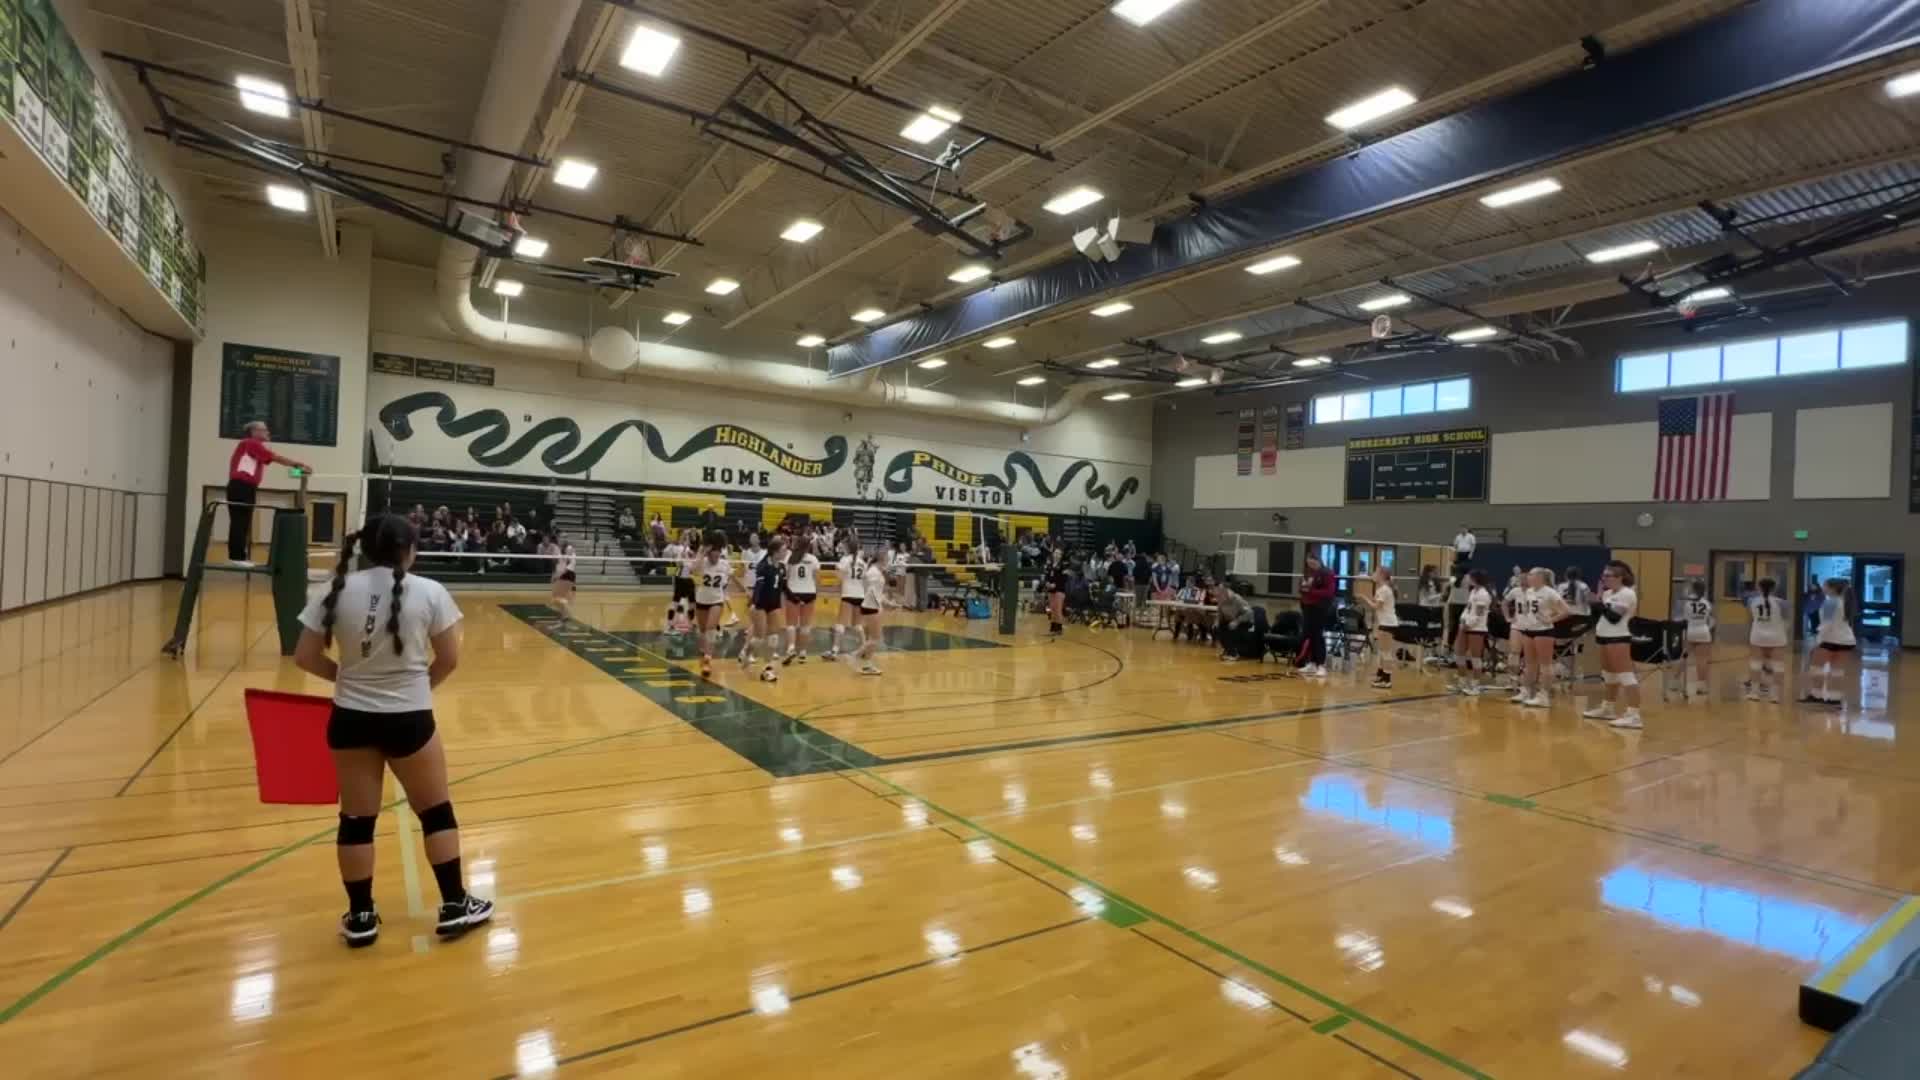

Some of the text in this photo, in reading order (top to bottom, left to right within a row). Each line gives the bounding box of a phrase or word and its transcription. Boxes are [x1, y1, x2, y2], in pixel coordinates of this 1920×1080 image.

[1443, 430, 1485, 442] SCHOOL
[714, 426, 823, 475] HIGHLANDER
[702, 466, 771, 488] HOME
[912, 452, 984, 486] PRIDE
[935, 486, 1013, 505] VISITOR
[703, 574, 722, 588] 22
[851, 567, 863, 580] 12
[1690, 602, 1707, 616] 12
